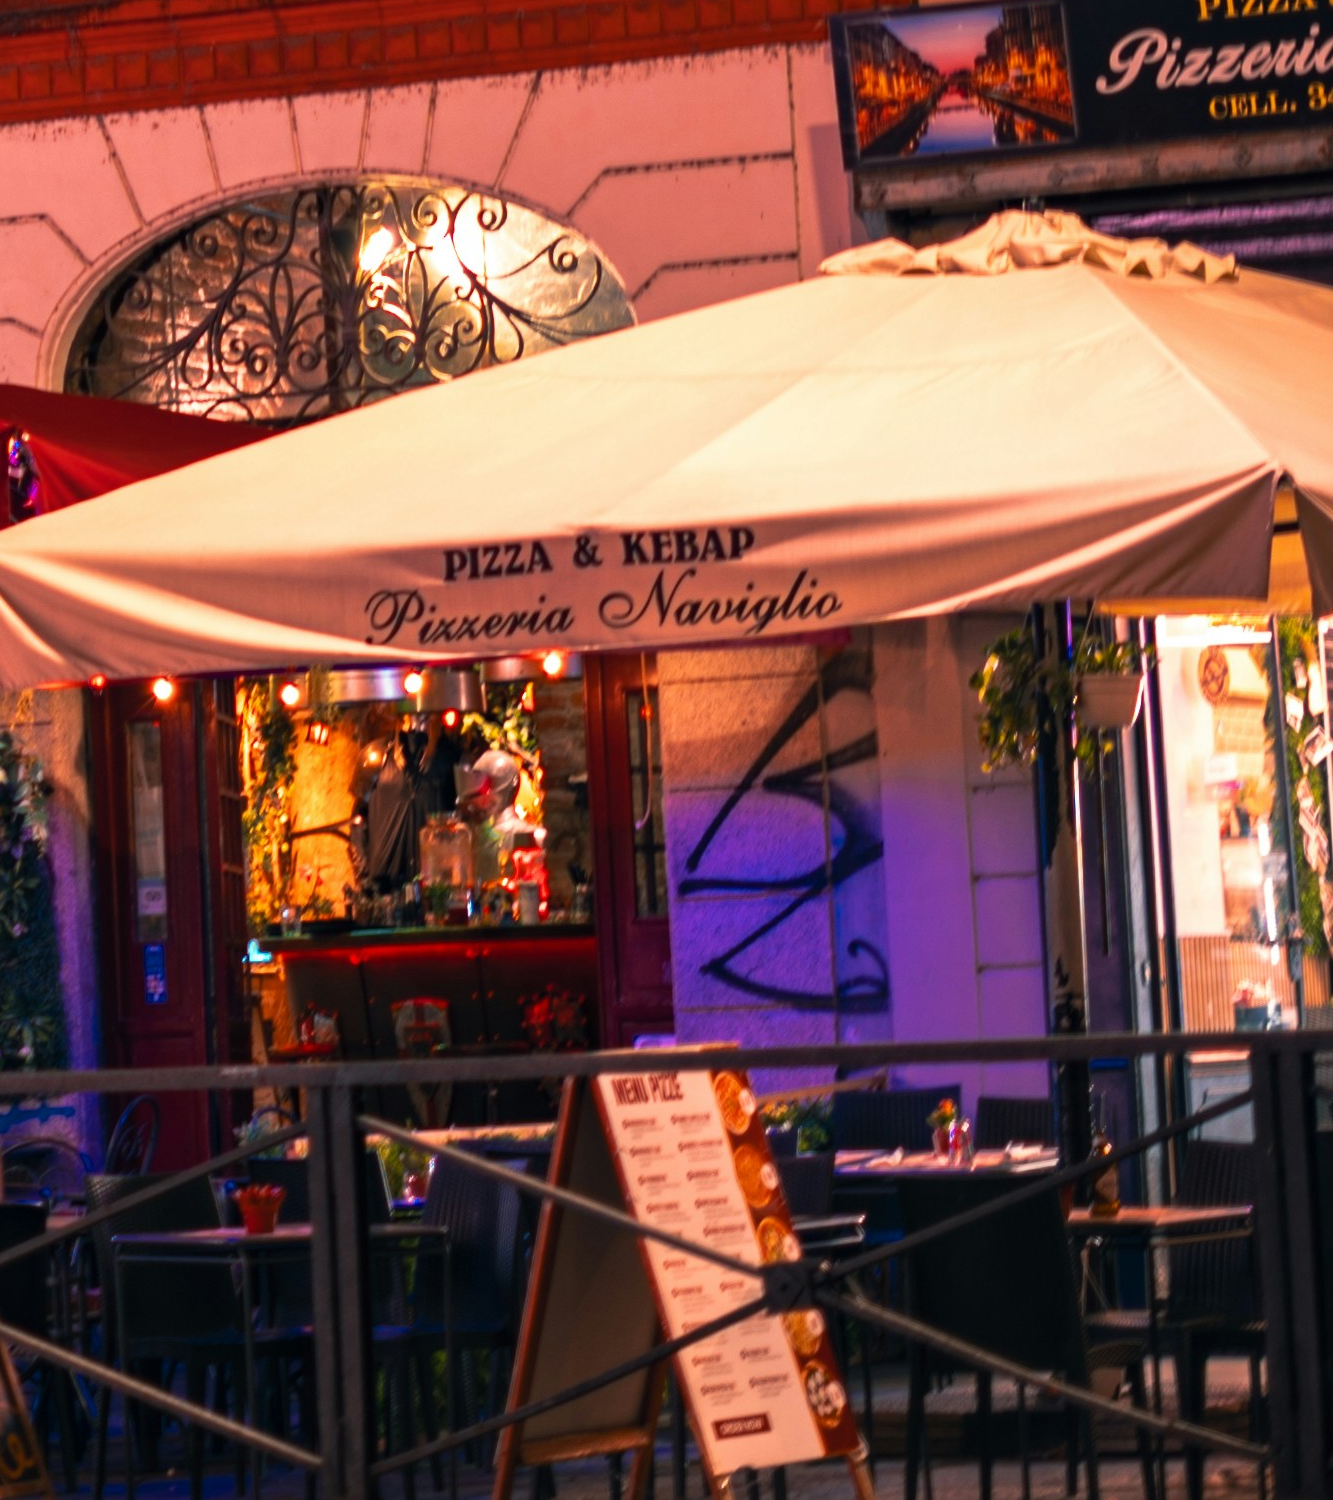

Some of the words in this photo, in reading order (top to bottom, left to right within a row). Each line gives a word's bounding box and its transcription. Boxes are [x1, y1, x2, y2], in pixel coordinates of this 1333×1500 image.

[1208, 89, 1298, 120] CELL.
[442, 539, 553, 583] PIZZA
[572, 533, 603, 568] &
[619, 526, 755, 566] KEBAP
[364, 589, 574, 645] Pizzeria
[598, 567, 843, 635] Naviglio
[611, 1075, 650, 1107] MENU
